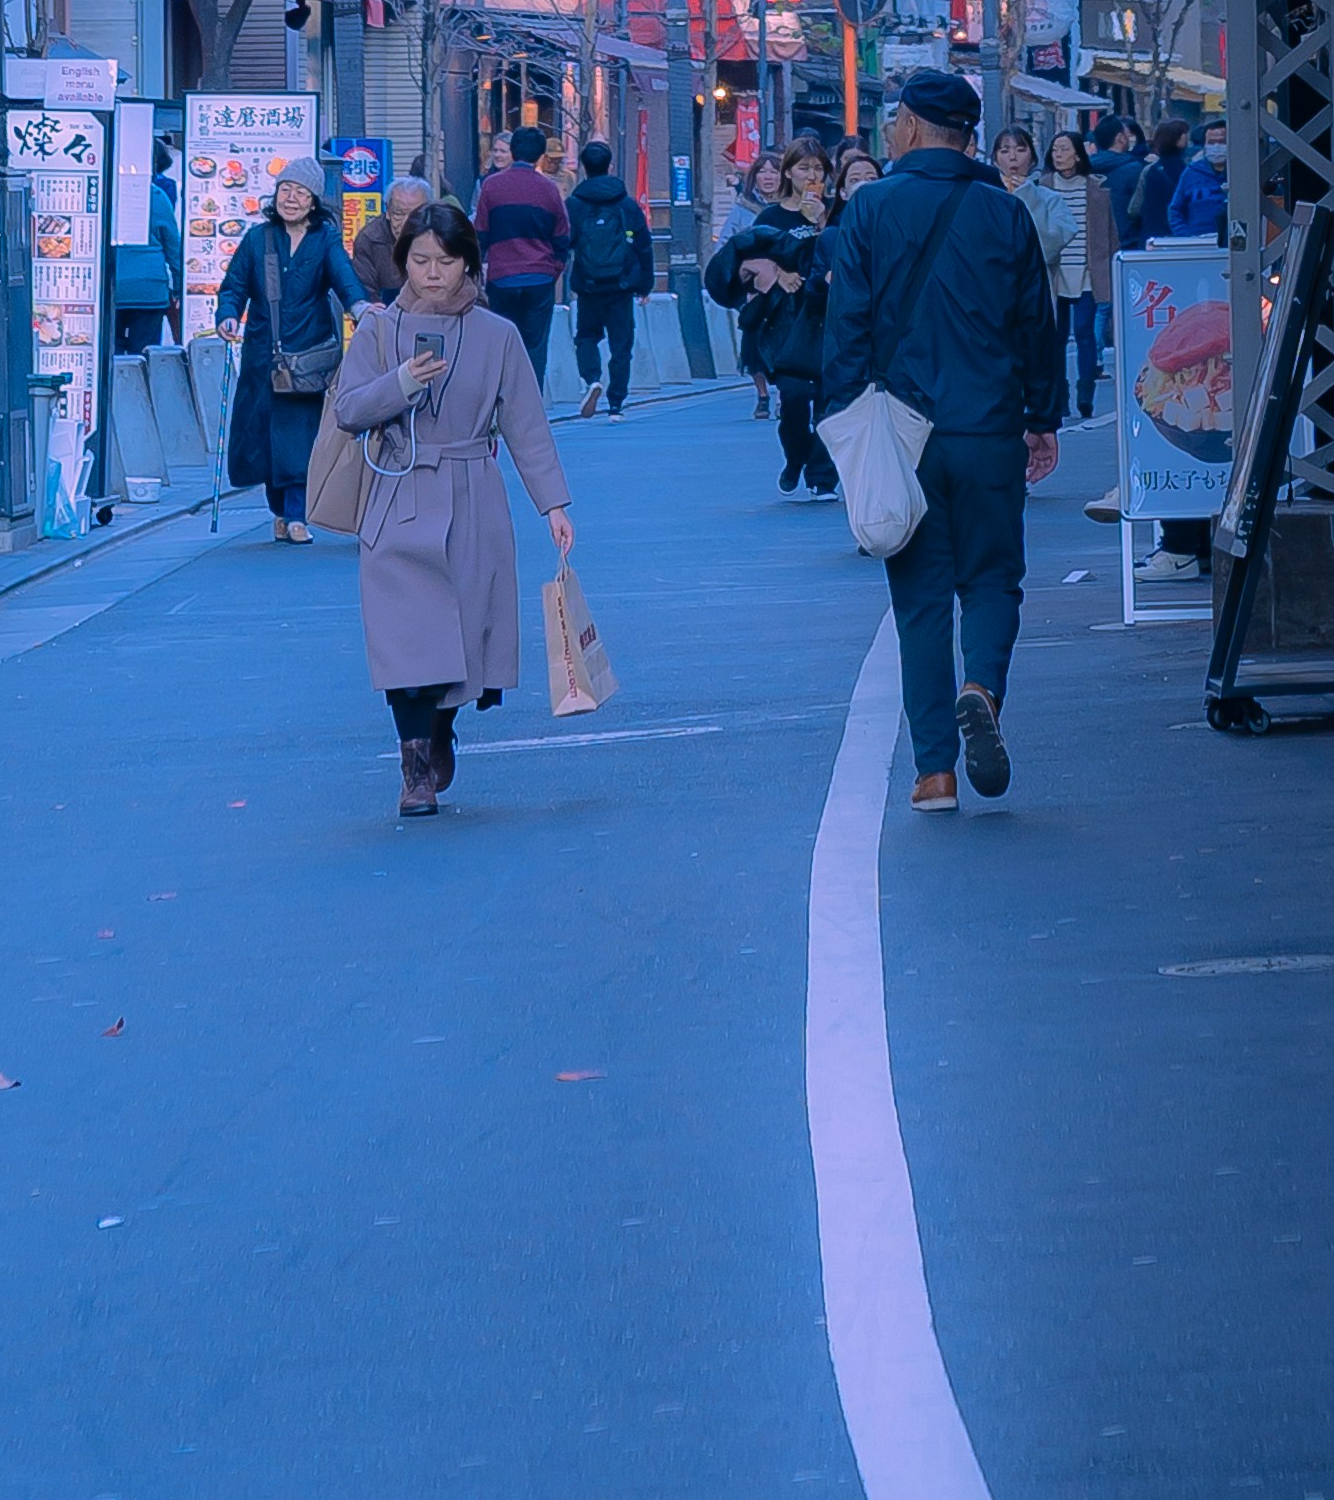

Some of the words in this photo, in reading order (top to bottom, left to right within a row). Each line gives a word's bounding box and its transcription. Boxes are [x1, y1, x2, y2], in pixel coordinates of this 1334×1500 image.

[61, 66, 101, 79] English
[65, 80, 95, 90] menu
[57, 91, 104, 104] available
[1132, 279, 1177, 329] 名
